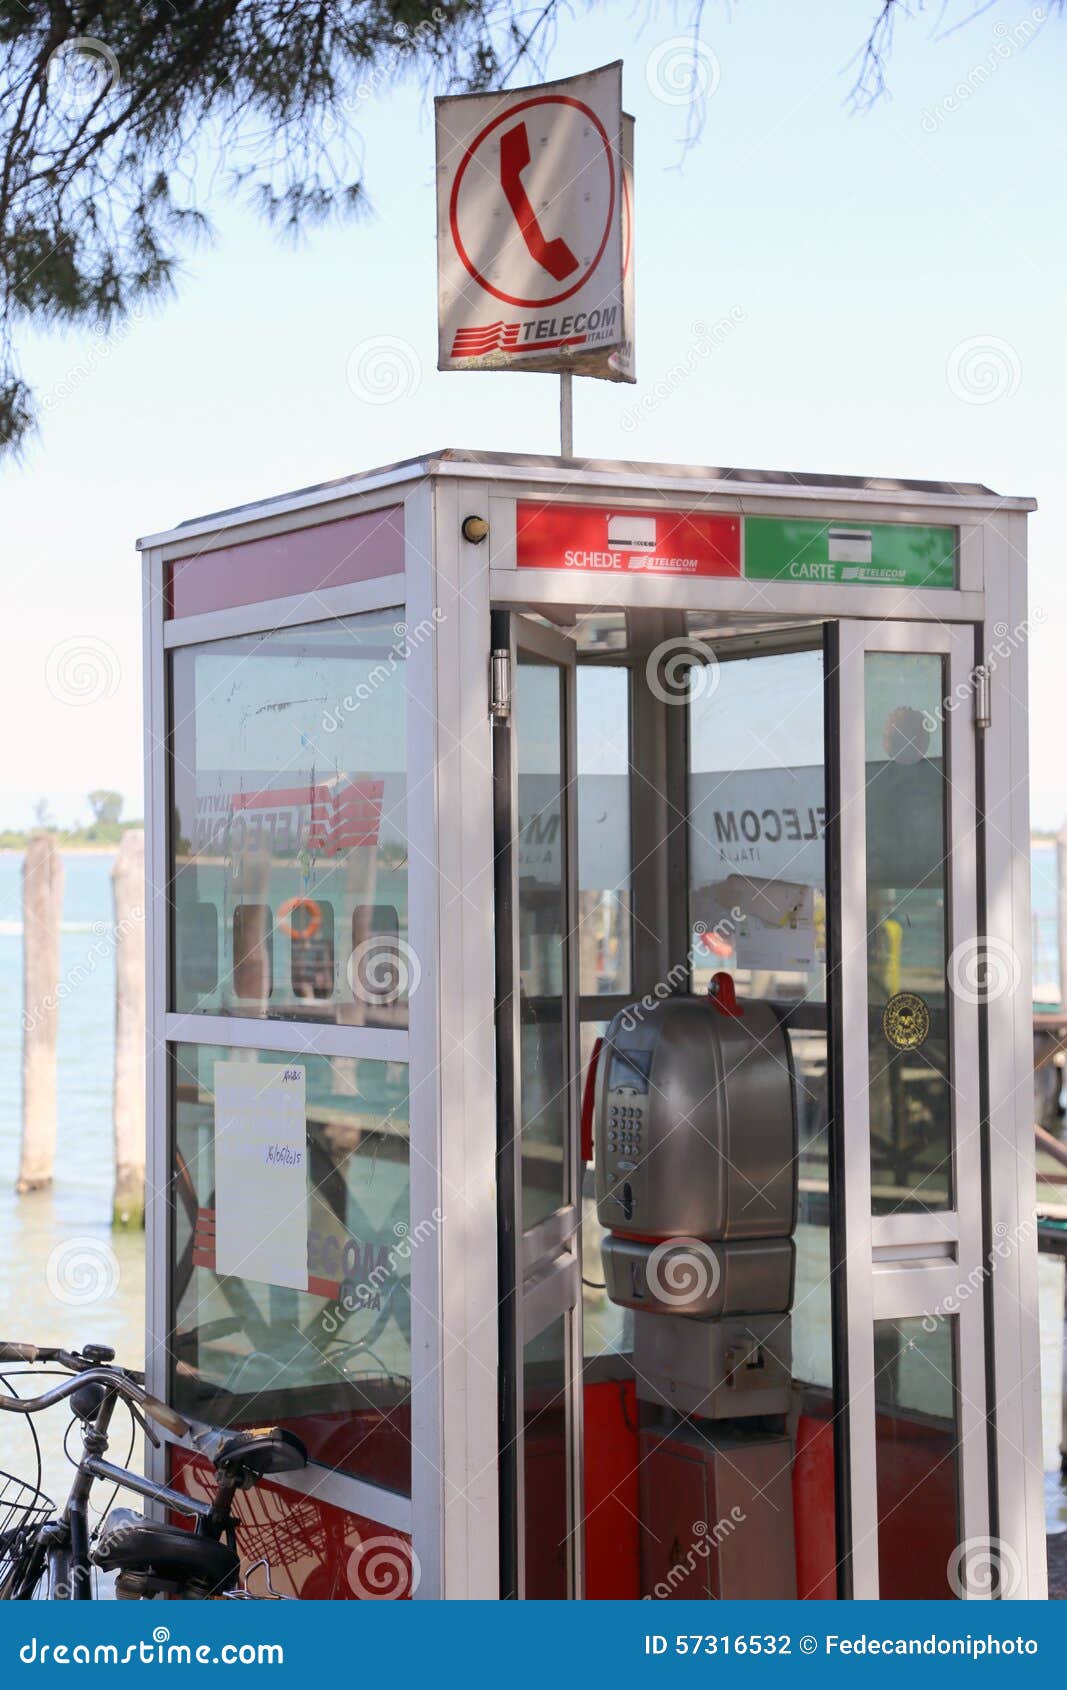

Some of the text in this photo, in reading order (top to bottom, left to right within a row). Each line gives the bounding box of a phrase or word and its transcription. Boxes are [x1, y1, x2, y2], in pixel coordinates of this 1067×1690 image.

[523, 306, 617, 340] TELECOM
[587, 329, 614, 342] ITALIA
[564, 551, 698, 569] SCHEDE TELECOM
[790, 562, 907, 580] CARTE TELECOM
